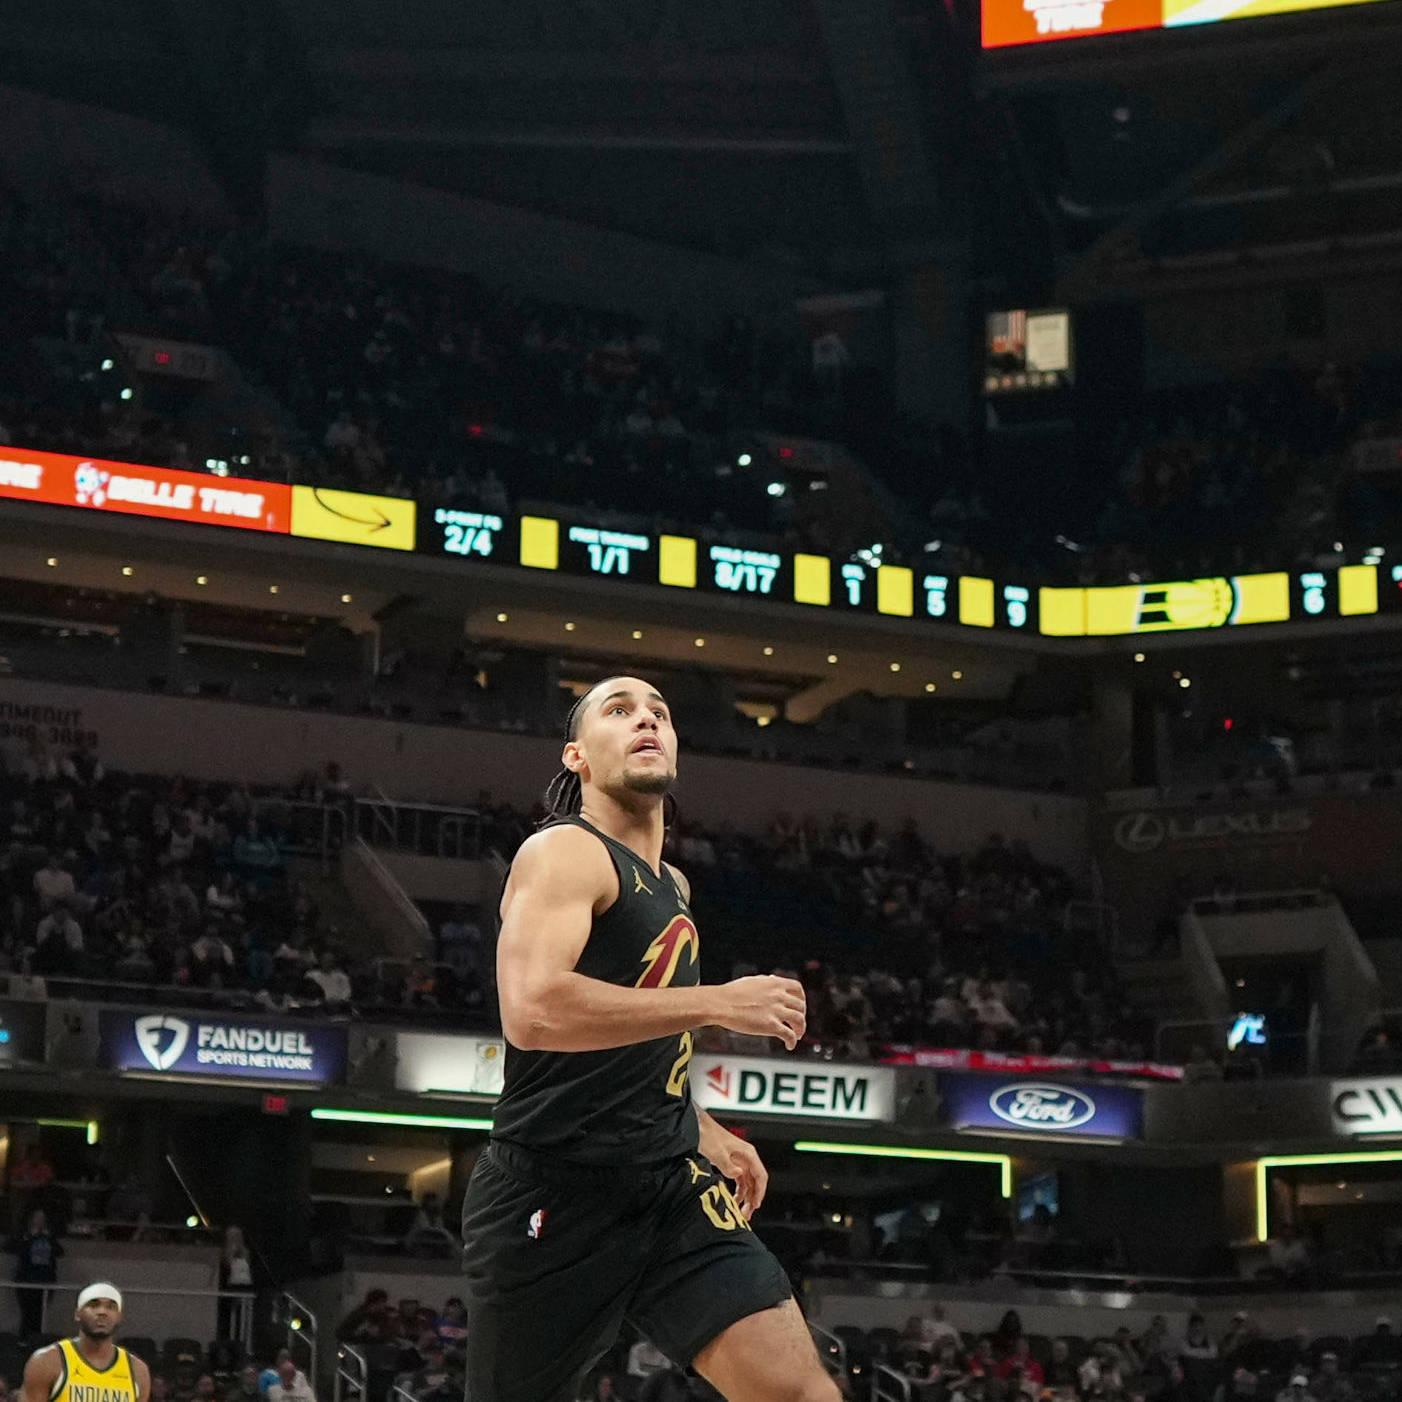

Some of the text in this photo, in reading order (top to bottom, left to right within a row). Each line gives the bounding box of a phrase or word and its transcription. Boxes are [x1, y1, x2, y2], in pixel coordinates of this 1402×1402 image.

[107, 475, 265, 519] BELLE TIRE
[444, 524, 493, 557] 2/4
[587, 542, 630, 576] 1/1
[714, 560, 777, 594] 8/17
[845, 579, 861, 606] 1
[926, 589, 946, 617] 5
[1007, 600, 1027, 627] 9
[1303, 587, 1326, 615] 6
[1167, 809, 1313, 840] LEXUS
[197, 1025, 314, 1055] FANDUEL
[197, 1049, 313, 1071] SPORTS NETWORK
[667, 1031, 695, 1098] 2
[736, 1069, 869, 1113] DEEM
[1009, 1087, 1076, 1124] Ford
[69, 1384, 131, 1402] INDIANA
